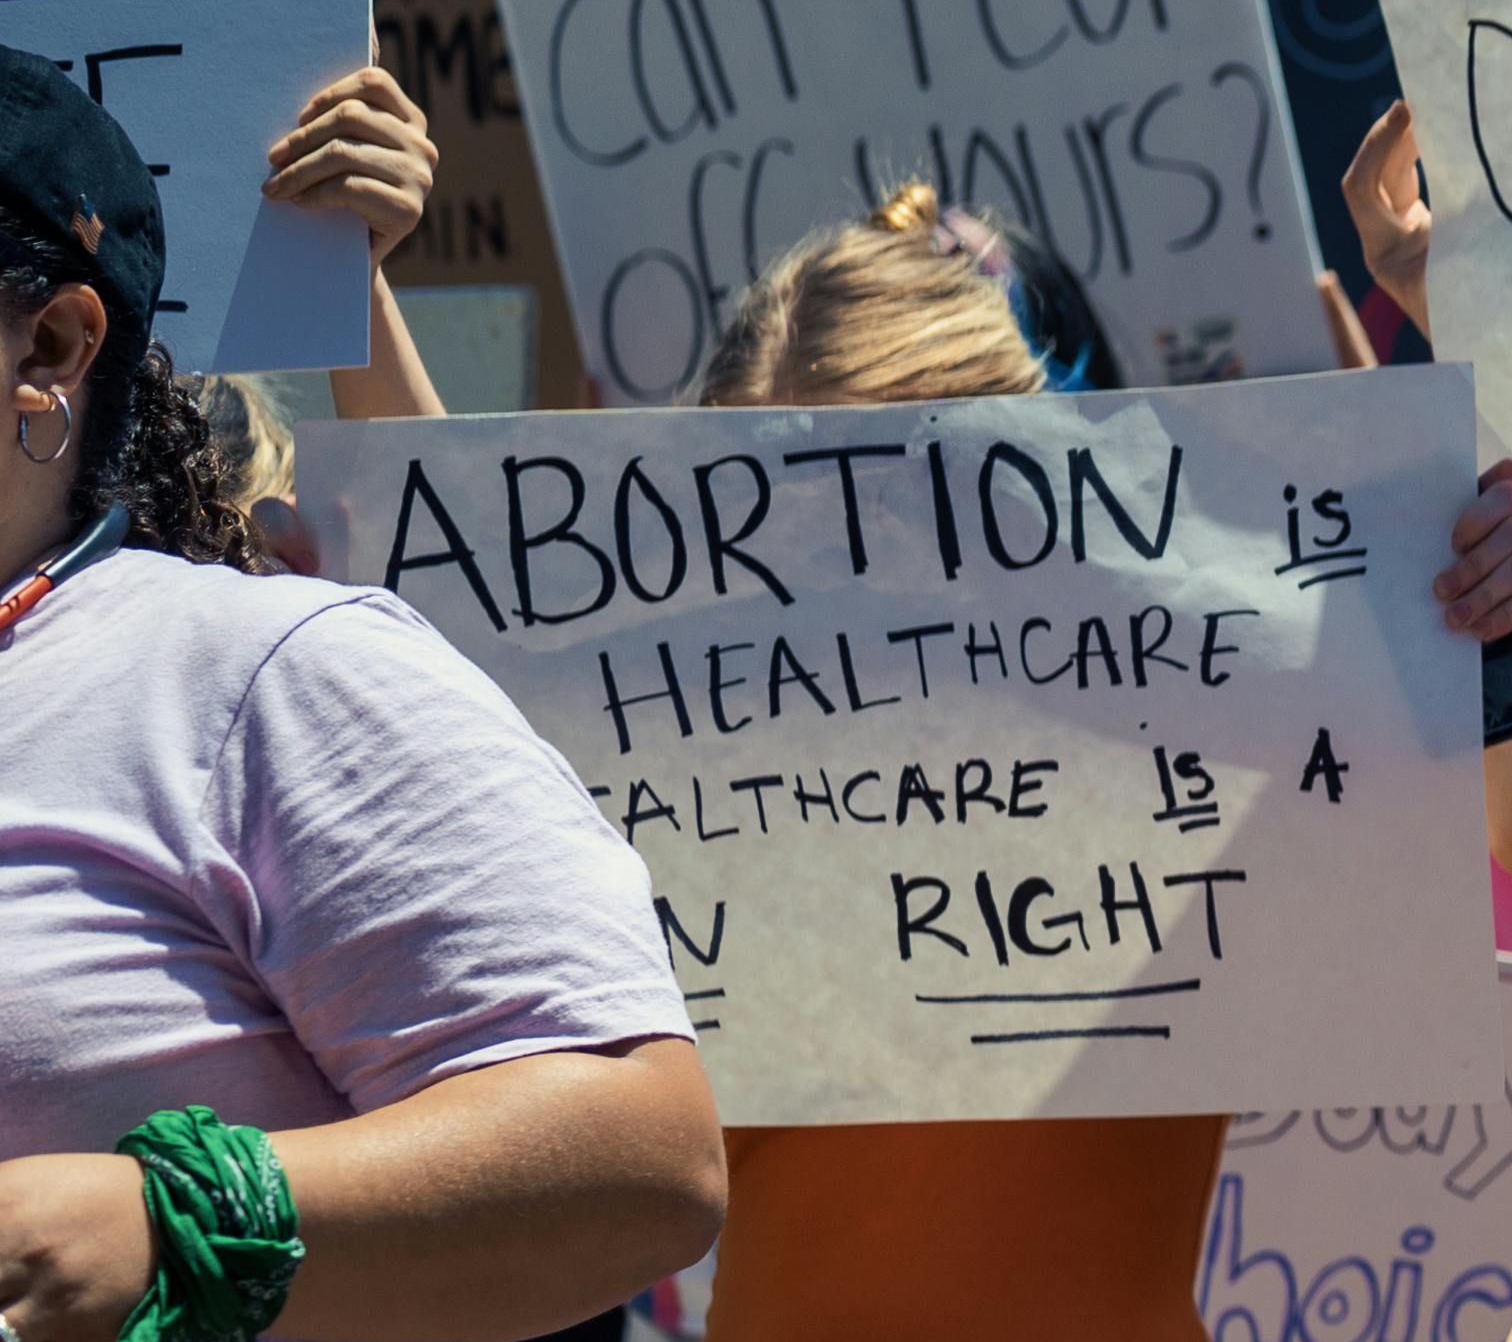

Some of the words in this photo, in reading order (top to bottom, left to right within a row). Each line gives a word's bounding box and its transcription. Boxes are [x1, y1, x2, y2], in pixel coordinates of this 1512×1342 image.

[383, 416, 1185, 633] ABORTION
[600, 603, 1261, 754] HEALTHCARE
[588, 760, 1061, 847] ALTHCARE
[1299, 727, 1350, 805] A
[892, 862, 1247, 966] RIGHT
